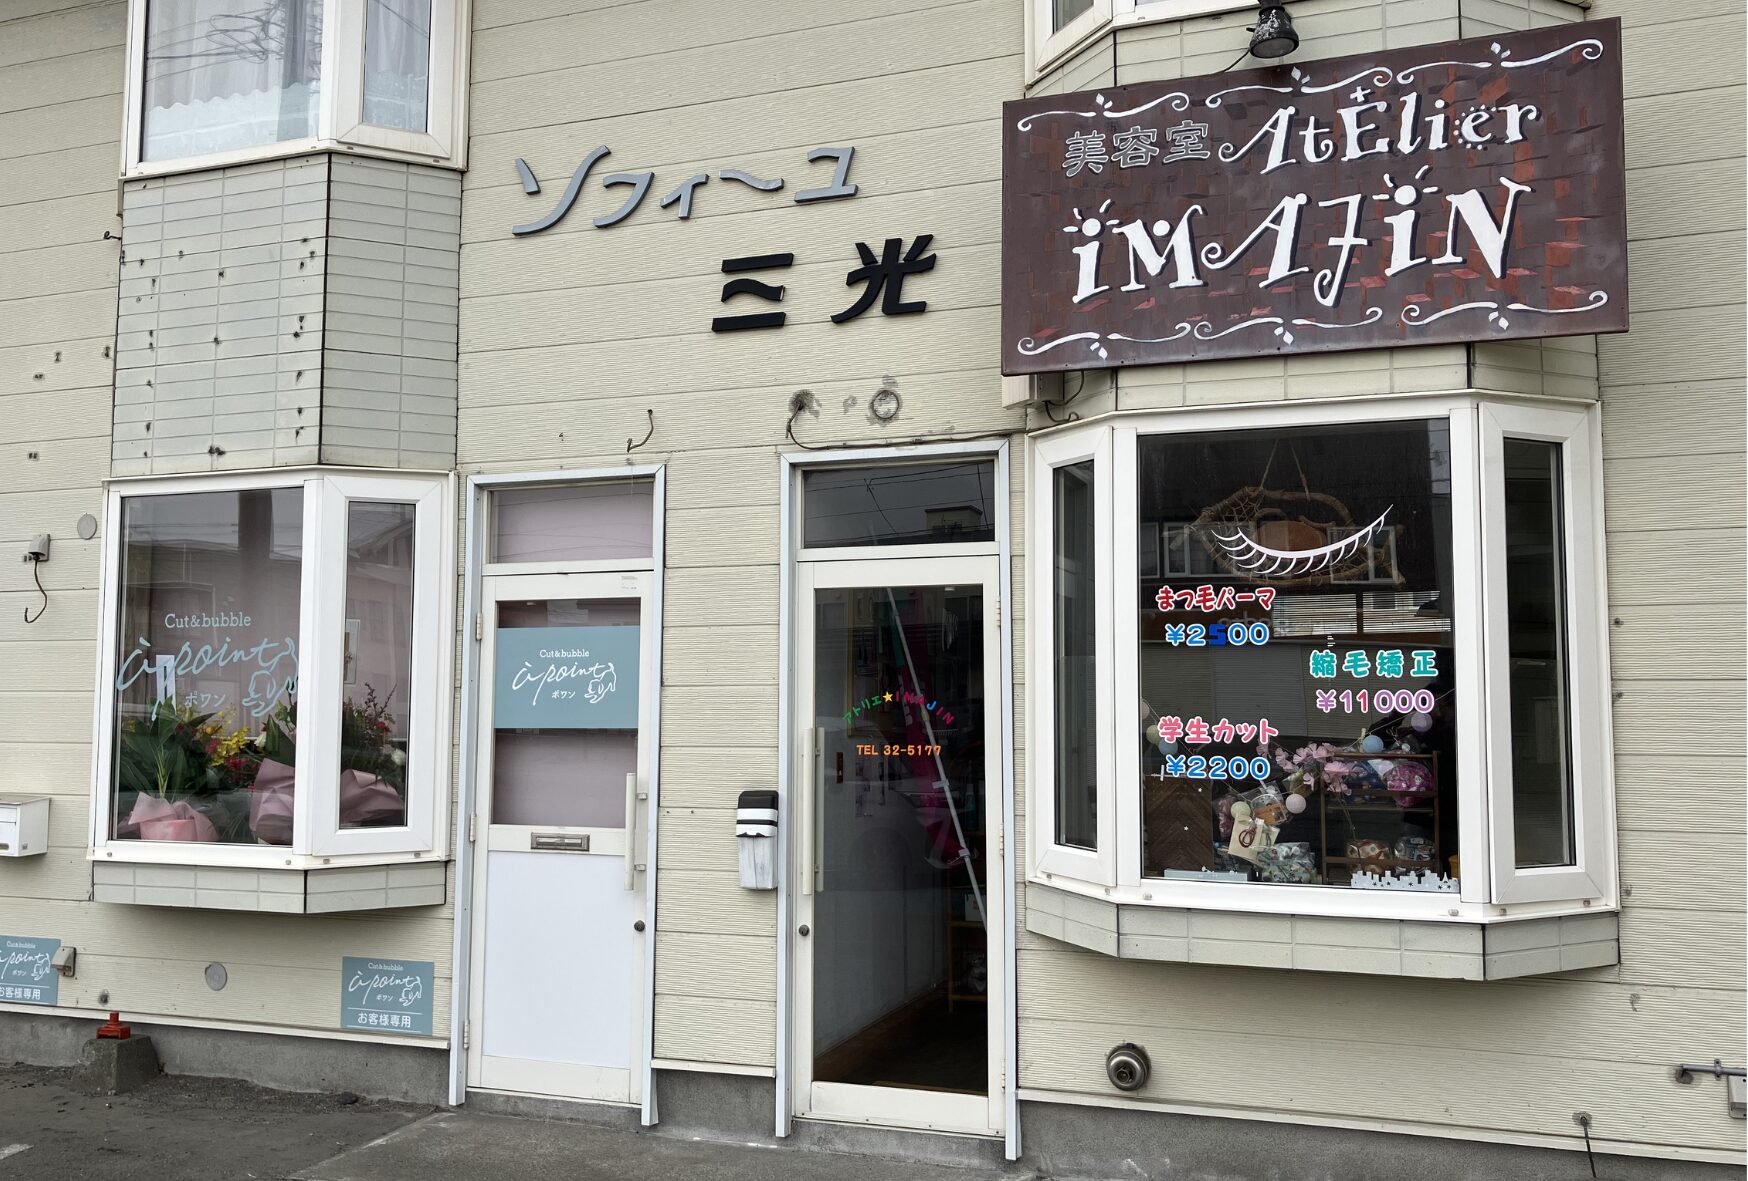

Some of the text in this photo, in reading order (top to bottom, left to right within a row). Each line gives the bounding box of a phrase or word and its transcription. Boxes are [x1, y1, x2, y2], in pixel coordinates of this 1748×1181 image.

[1064, 119, 1212, 178] 美容室
[511, 144, 859, 236] ソフィーユ
[711, 234, 937, 332] 三光
[1156, 584, 1276, 612] まつ毛パーマ
[165, 611, 252, 628] Cut&bubble
[1165, 622, 1270, 646] ¥2500
[539, 649, 590, 658] Cut&bubble
[1309, 650, 1439, 678] 縮毛矯正
[1316, 689, 1435, 713] ¥11000
[1157, 716, 1279, 744] 学生カット
[856, 744, 942, 757] TEL 32-5177
[1166, 755, 1271, 780] ¥2200
[357, 1011, 411, 1028] お客様専用
